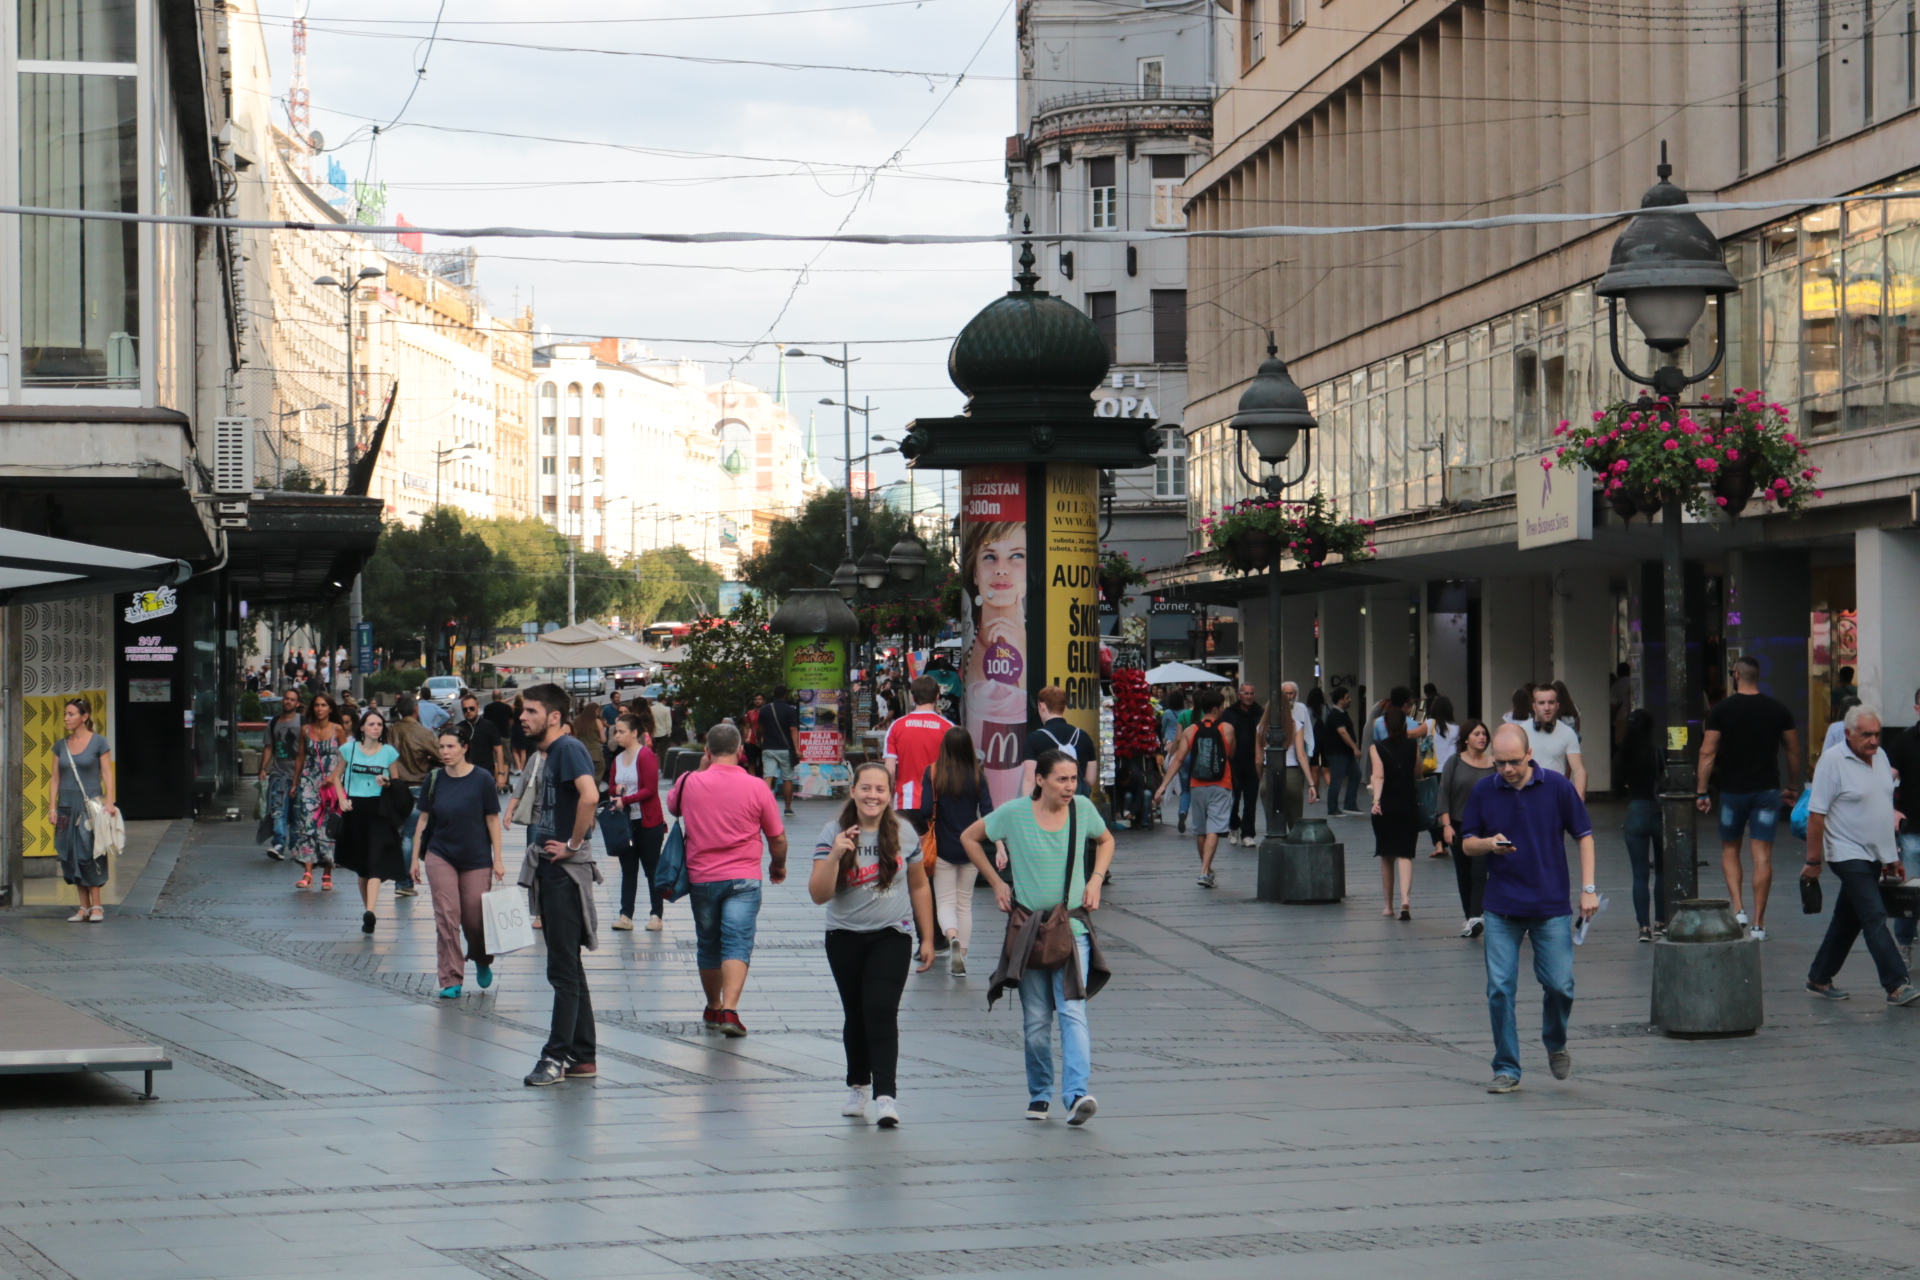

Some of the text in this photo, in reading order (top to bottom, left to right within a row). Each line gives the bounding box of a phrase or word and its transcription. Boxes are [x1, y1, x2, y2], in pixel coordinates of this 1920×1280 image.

[1094, 396, 1159, 419] OPA
[972, 483, 1019, 496] BEZISTAN
[969, 500, 1001, 515] 300m
[138, 636, 161, 646] 24/7
[905, 719, 922, 728] CRVENA
[497, 908, 523, 930] OVS
